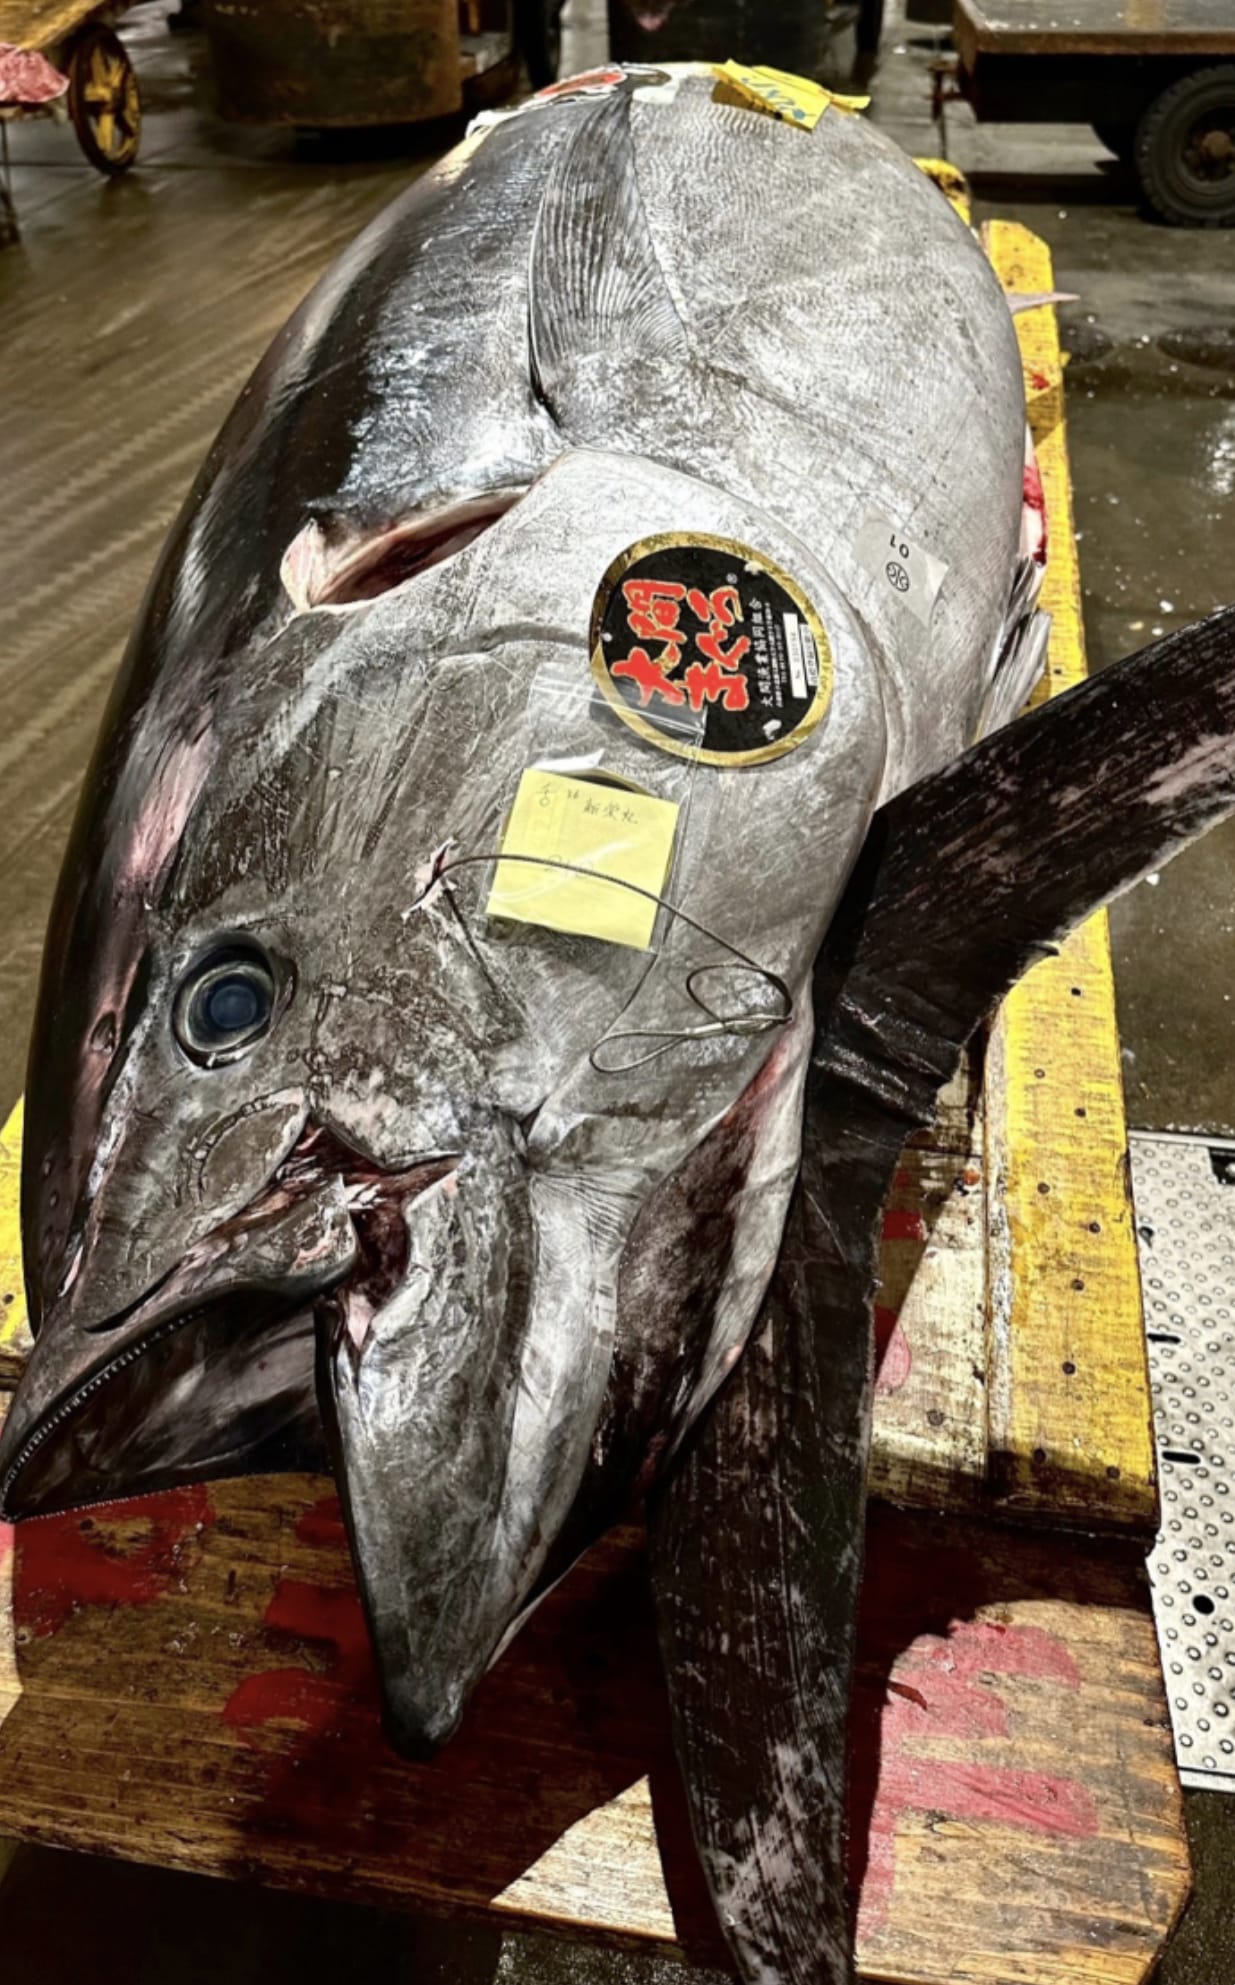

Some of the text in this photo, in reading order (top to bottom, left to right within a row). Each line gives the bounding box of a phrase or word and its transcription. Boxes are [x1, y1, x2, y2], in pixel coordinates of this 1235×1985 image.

[610, 579, 687, 707] 大間
[675, 585, 751, 712] まぐろ
